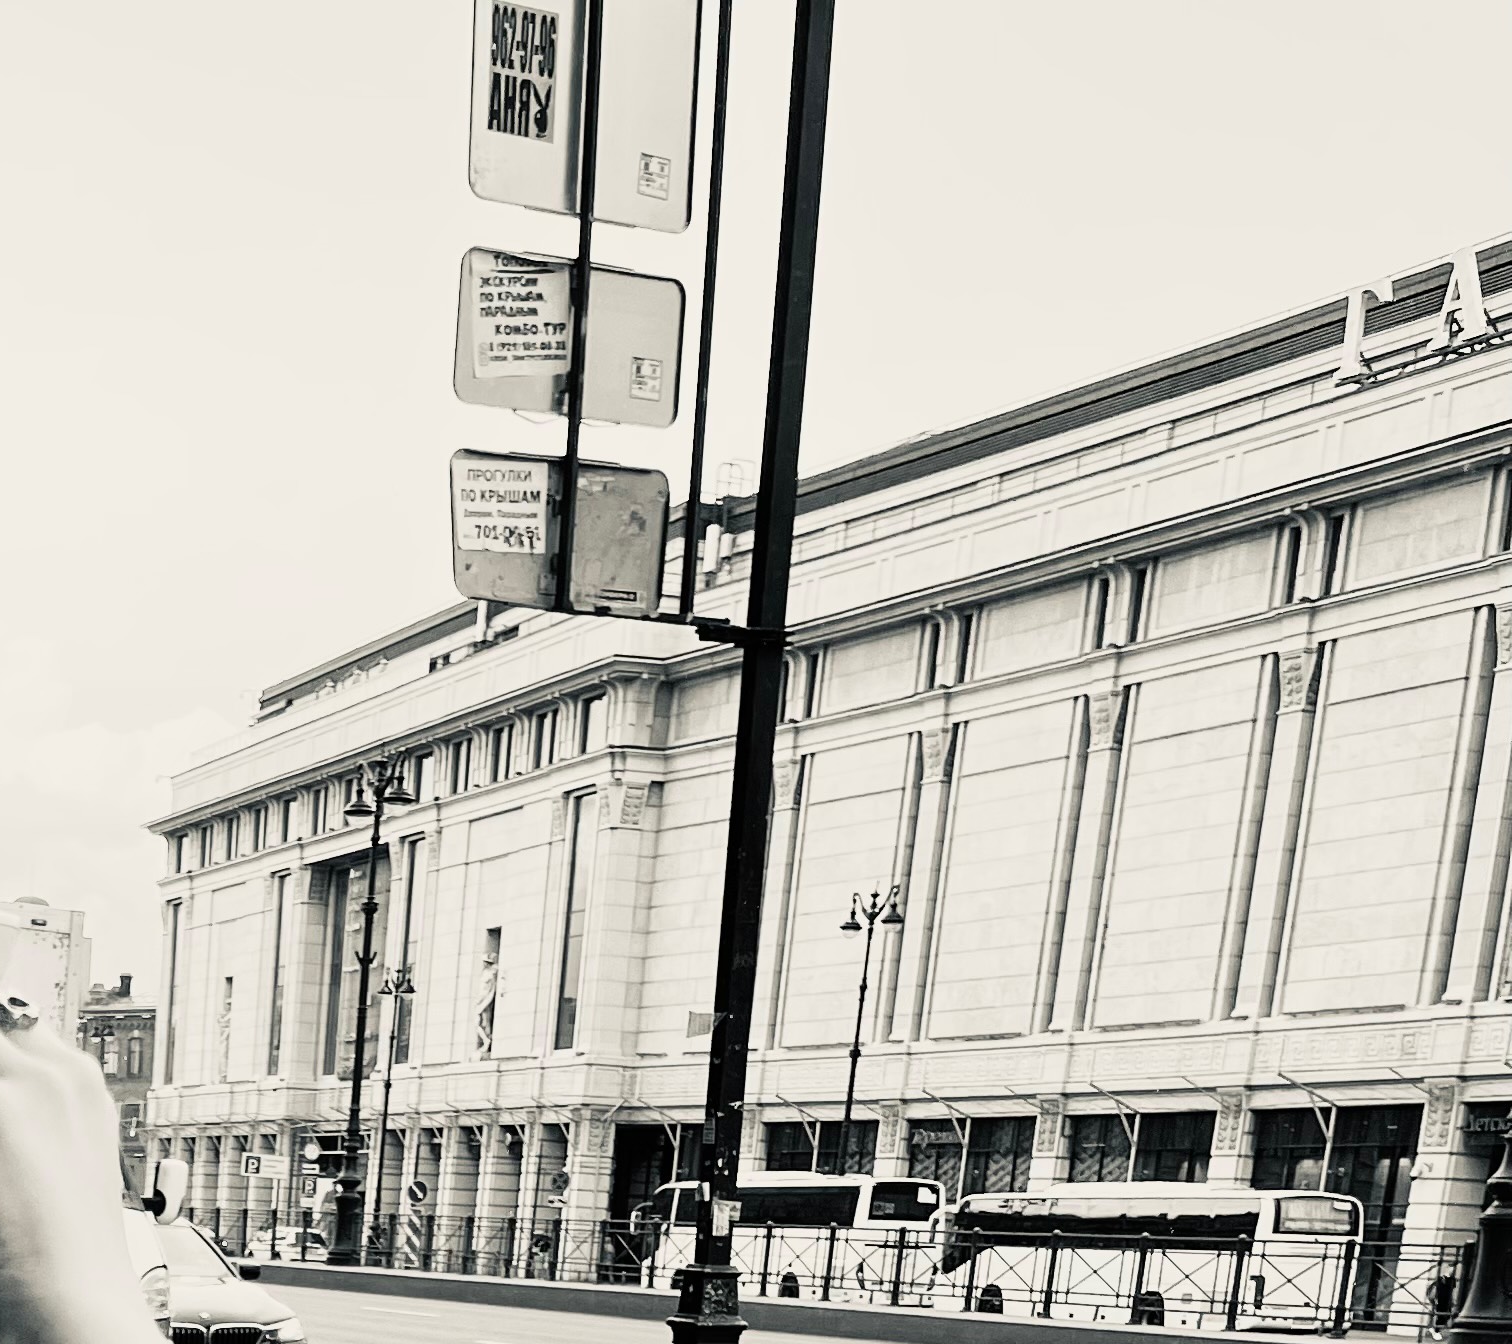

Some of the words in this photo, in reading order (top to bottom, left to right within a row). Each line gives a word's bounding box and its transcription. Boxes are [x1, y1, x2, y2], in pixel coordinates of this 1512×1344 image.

[487, 71, 531, 138] АНЯ
[467, 468, 533, 482] ПРОГУЛКИ
[461, 488, 477, 502] ПО
[480, 489, 541, 503] КРЫШАМ
